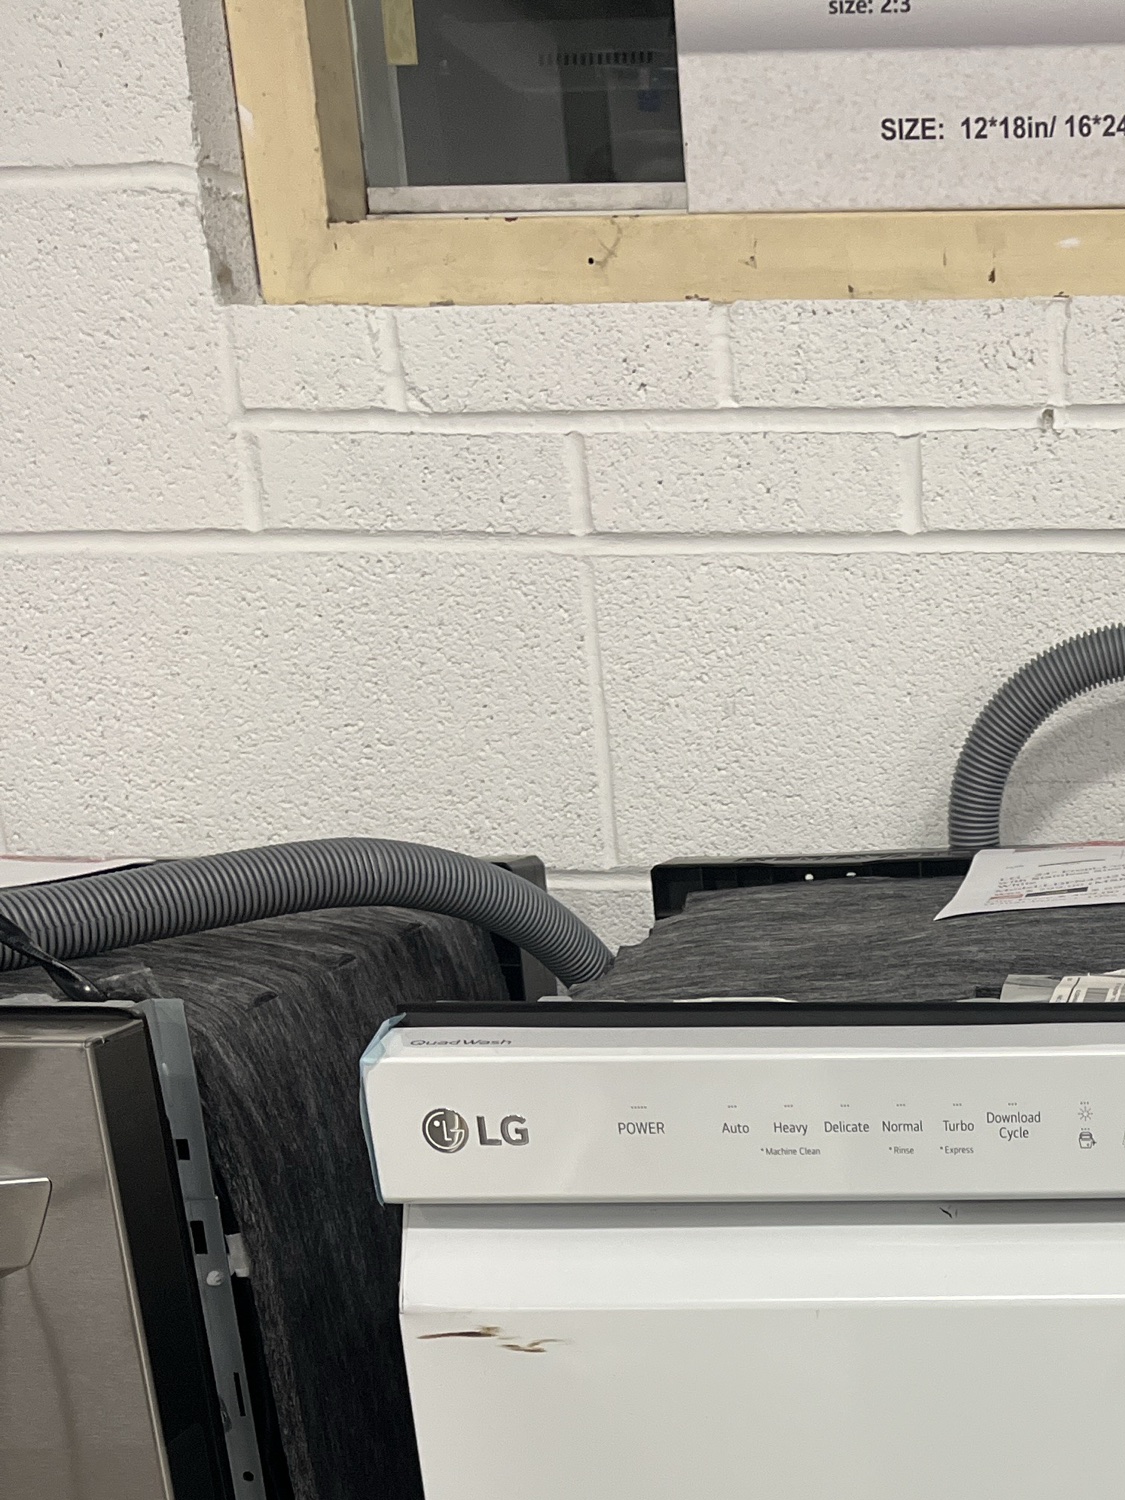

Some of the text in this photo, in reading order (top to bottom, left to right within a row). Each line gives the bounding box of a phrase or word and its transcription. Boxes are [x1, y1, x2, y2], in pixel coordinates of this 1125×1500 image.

[828, 0, 874, 14] size:
[880, 117, 945, 141] SIZE:
[985, 1110, 1042, 1124] Download
[475, 1114, 531, 1147] LG
[617, 1121, 666, 1135] POWER
[721, 1122, 750, 1134] Auto
[773, 1121, 809, 1136] Heavy
[823, 1120, 870, 1133] Delicate
[881, 1119, 924, 1132] Normal
[942, 1119, 975, 1132] Turbo
[998, 1126, 1030, 1141] Cycle
[799, 1146, 821, 1155] Clean
